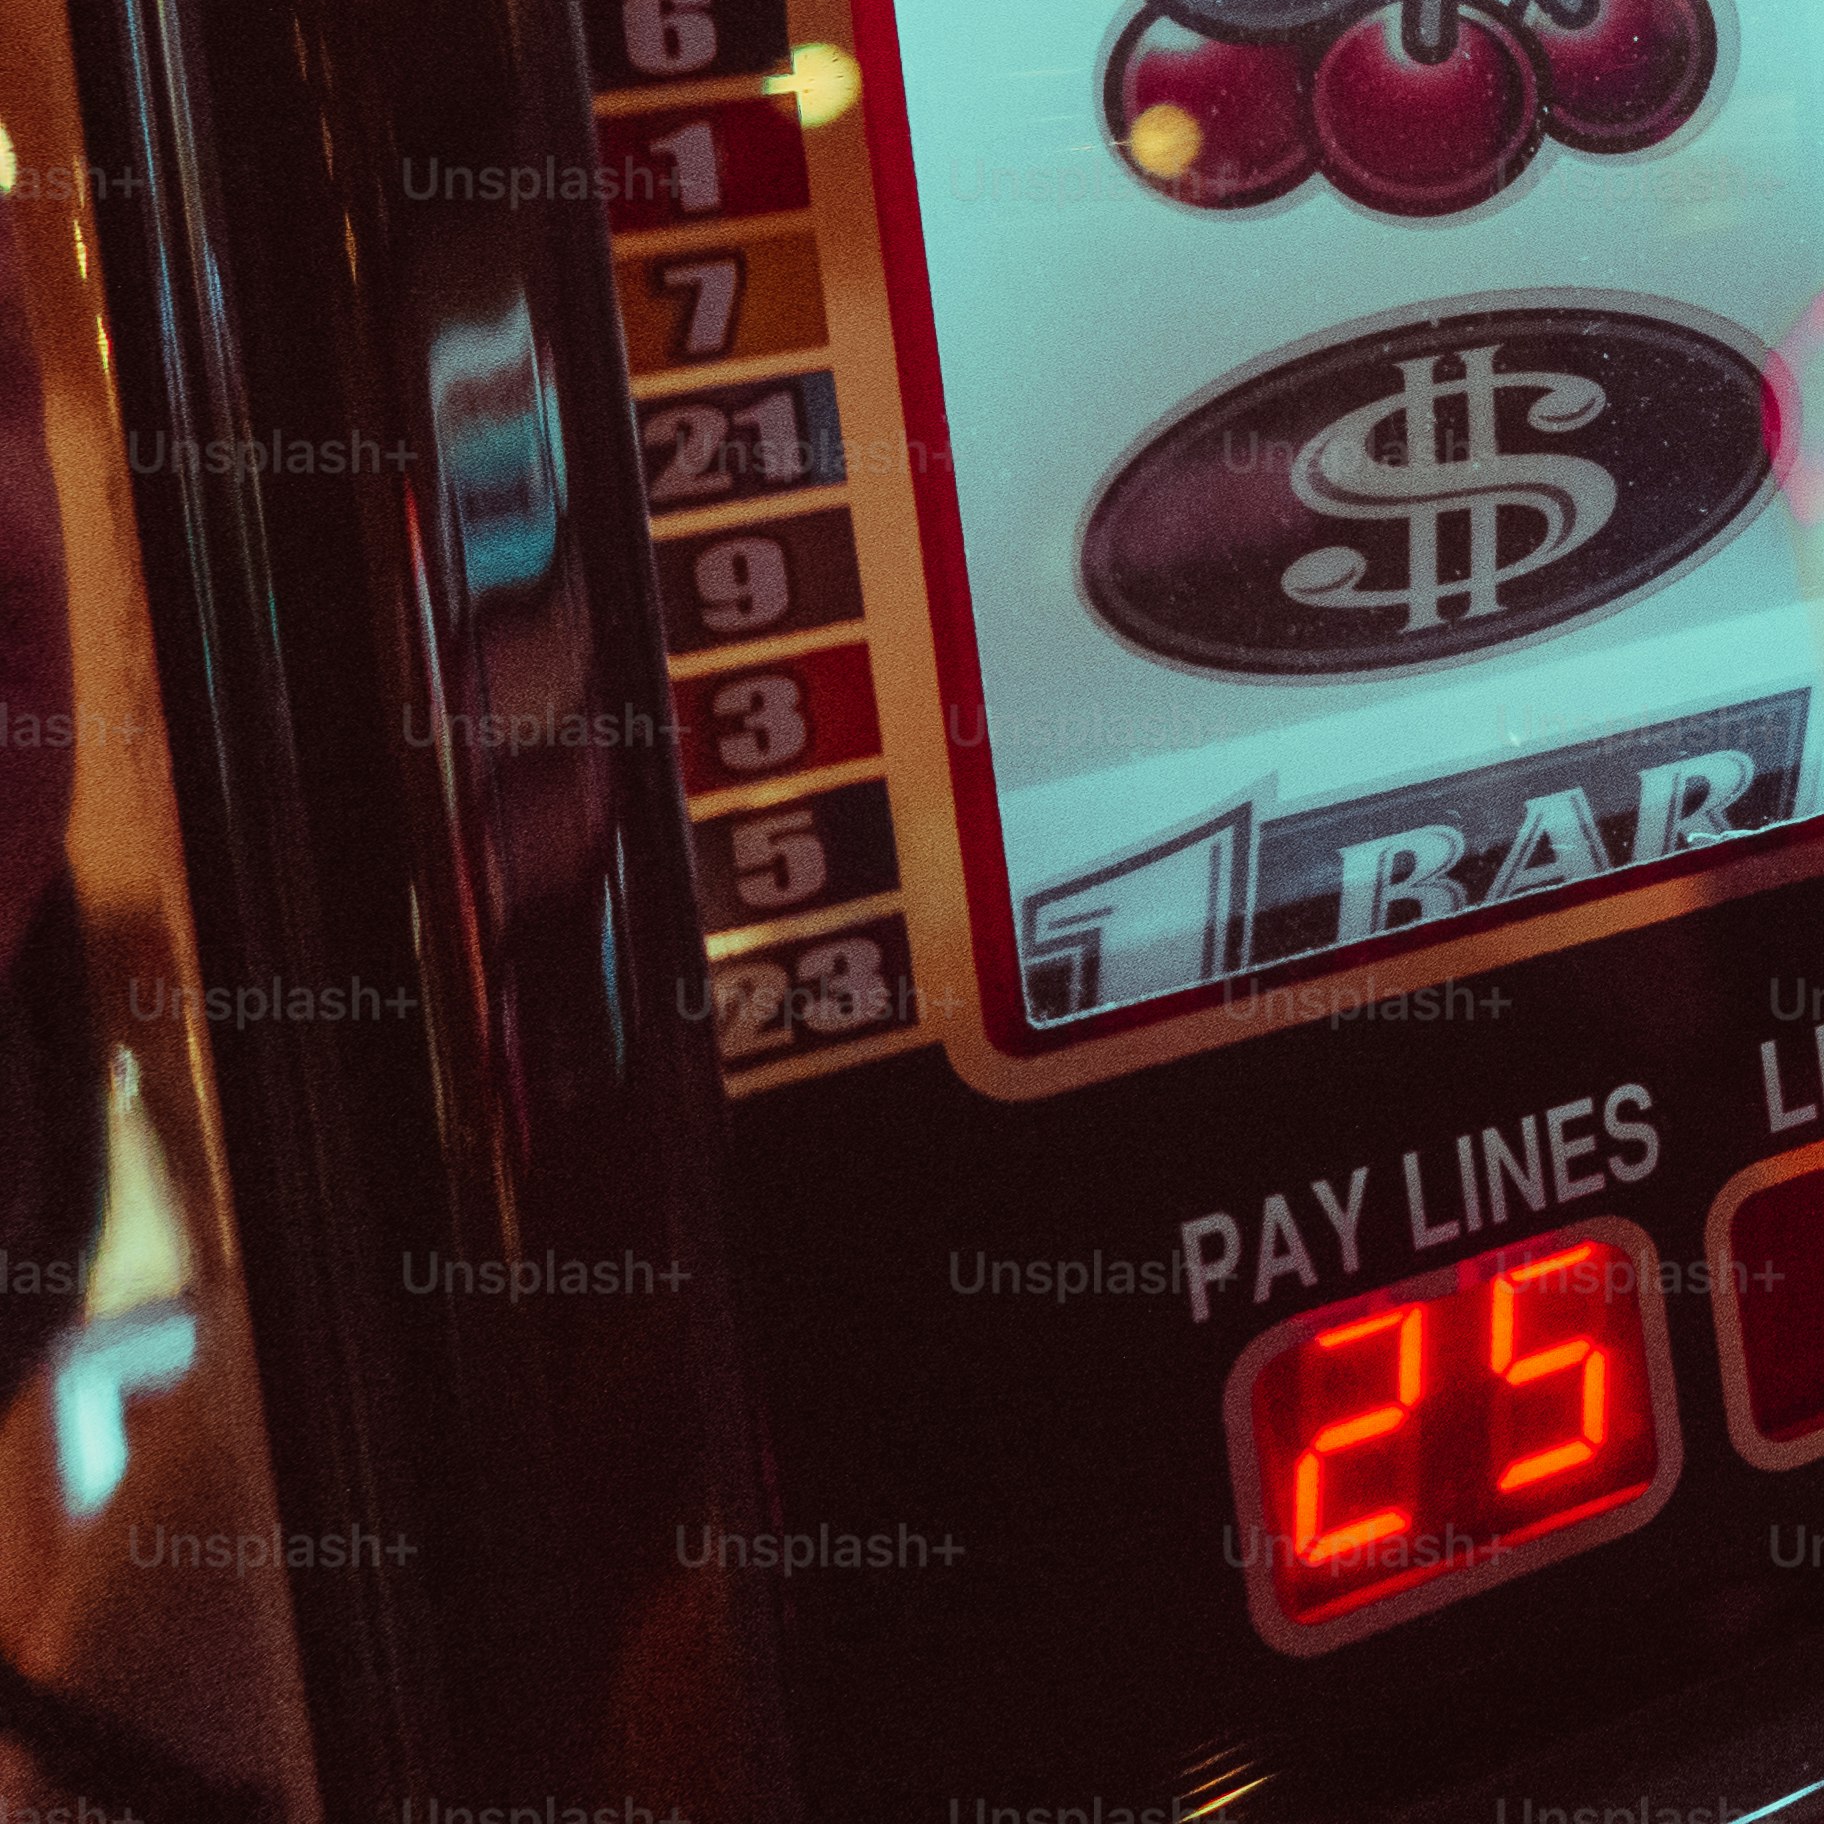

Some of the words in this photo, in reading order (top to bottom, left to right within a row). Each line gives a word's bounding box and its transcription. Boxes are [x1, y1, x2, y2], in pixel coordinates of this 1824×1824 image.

[650, 124, 722, 212] 1
[664, 259, 737, 354] 7
[643, 392, 801, 500] 21
[697, 538, 789, 633] 9
[712, 676, 805, 770] 3
[732, 810, 825, 907] 5
[712, 938, 882, 1057] 23
[1179, 1164, 1373, 1323] PAY
[1401, 1081, 1663, 1250] LINES
[1292, 1235, 1611, 1567] 25
